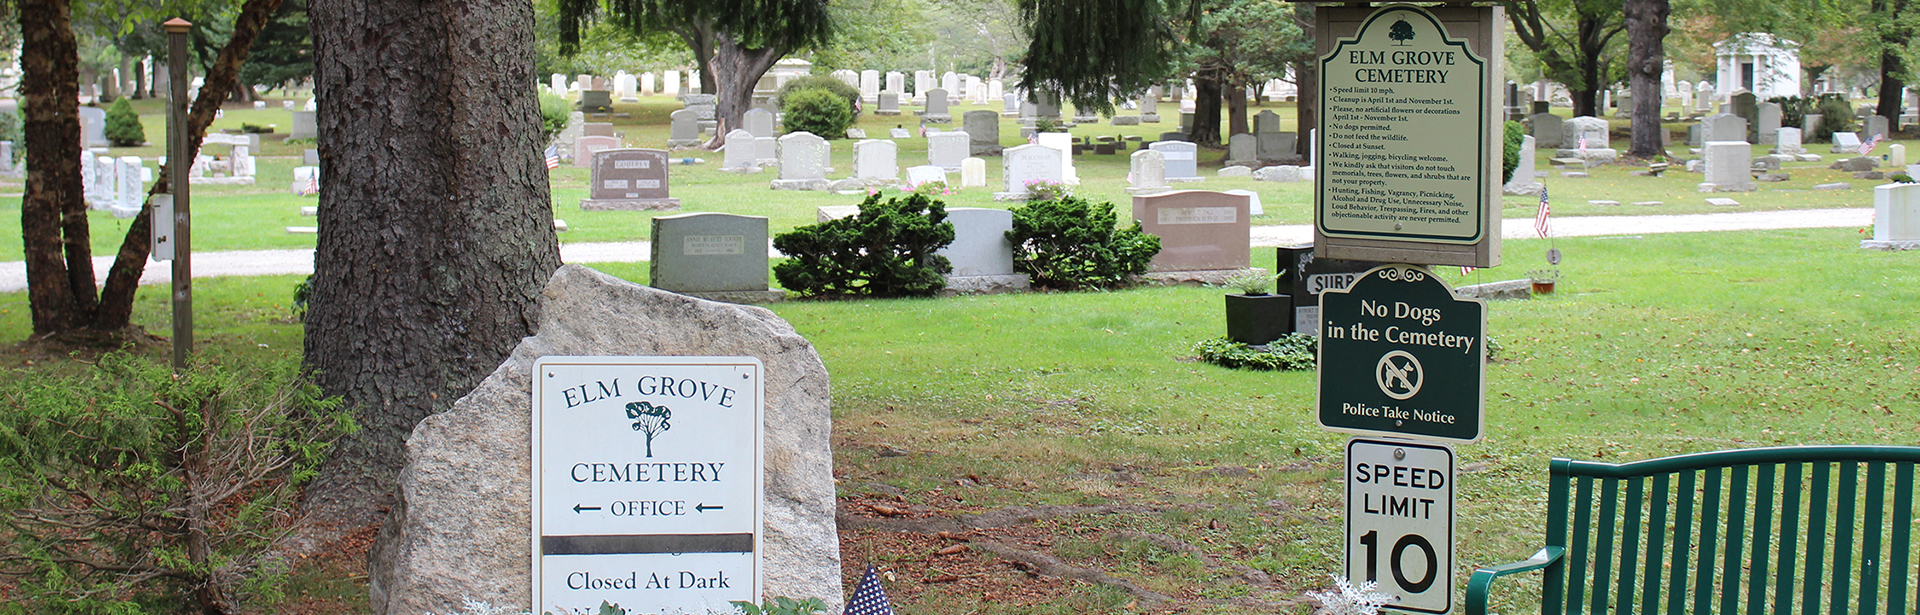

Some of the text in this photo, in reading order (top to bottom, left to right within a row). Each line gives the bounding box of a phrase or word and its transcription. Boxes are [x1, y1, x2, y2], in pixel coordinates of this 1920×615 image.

[1349, 51, 1455, 66] ELM GROVE
[1355, 69, 1449, 84] CEMETERY
[1333, 96, 1359, 104] Cleanup
[1333, 152, 1360, 160] Walking,
[1388, 154, 1417, 162] bicycling
[1332, 187, 1359, 195] Hunting,
[1362, 188, 1386, 196] Fishing,
[1420, 191, 1455, 199] Picnicking,
[1403, 198, 1442, 207] Unnecessary
[1380, 206, 1418, 214] Trespassing,
[1361, 300, 1441, 326] No Dogs
[1328, 321, 1474, 354] in the Cemetery
[562, 375, 736, 409] ELM GROVE
[1342, 403, 1455, 424] Police Take Notice
[571, 463, 725, 482] CEMETERY
[1356, 463, 1445, 490] SPEED
[611, 501, 686, 516] OFFICE
[1364, 493, 1434, 520] LIMIT
[1360, 530, 1438, 594] 10
[567, 571, 730, 590] Closed At Dark
